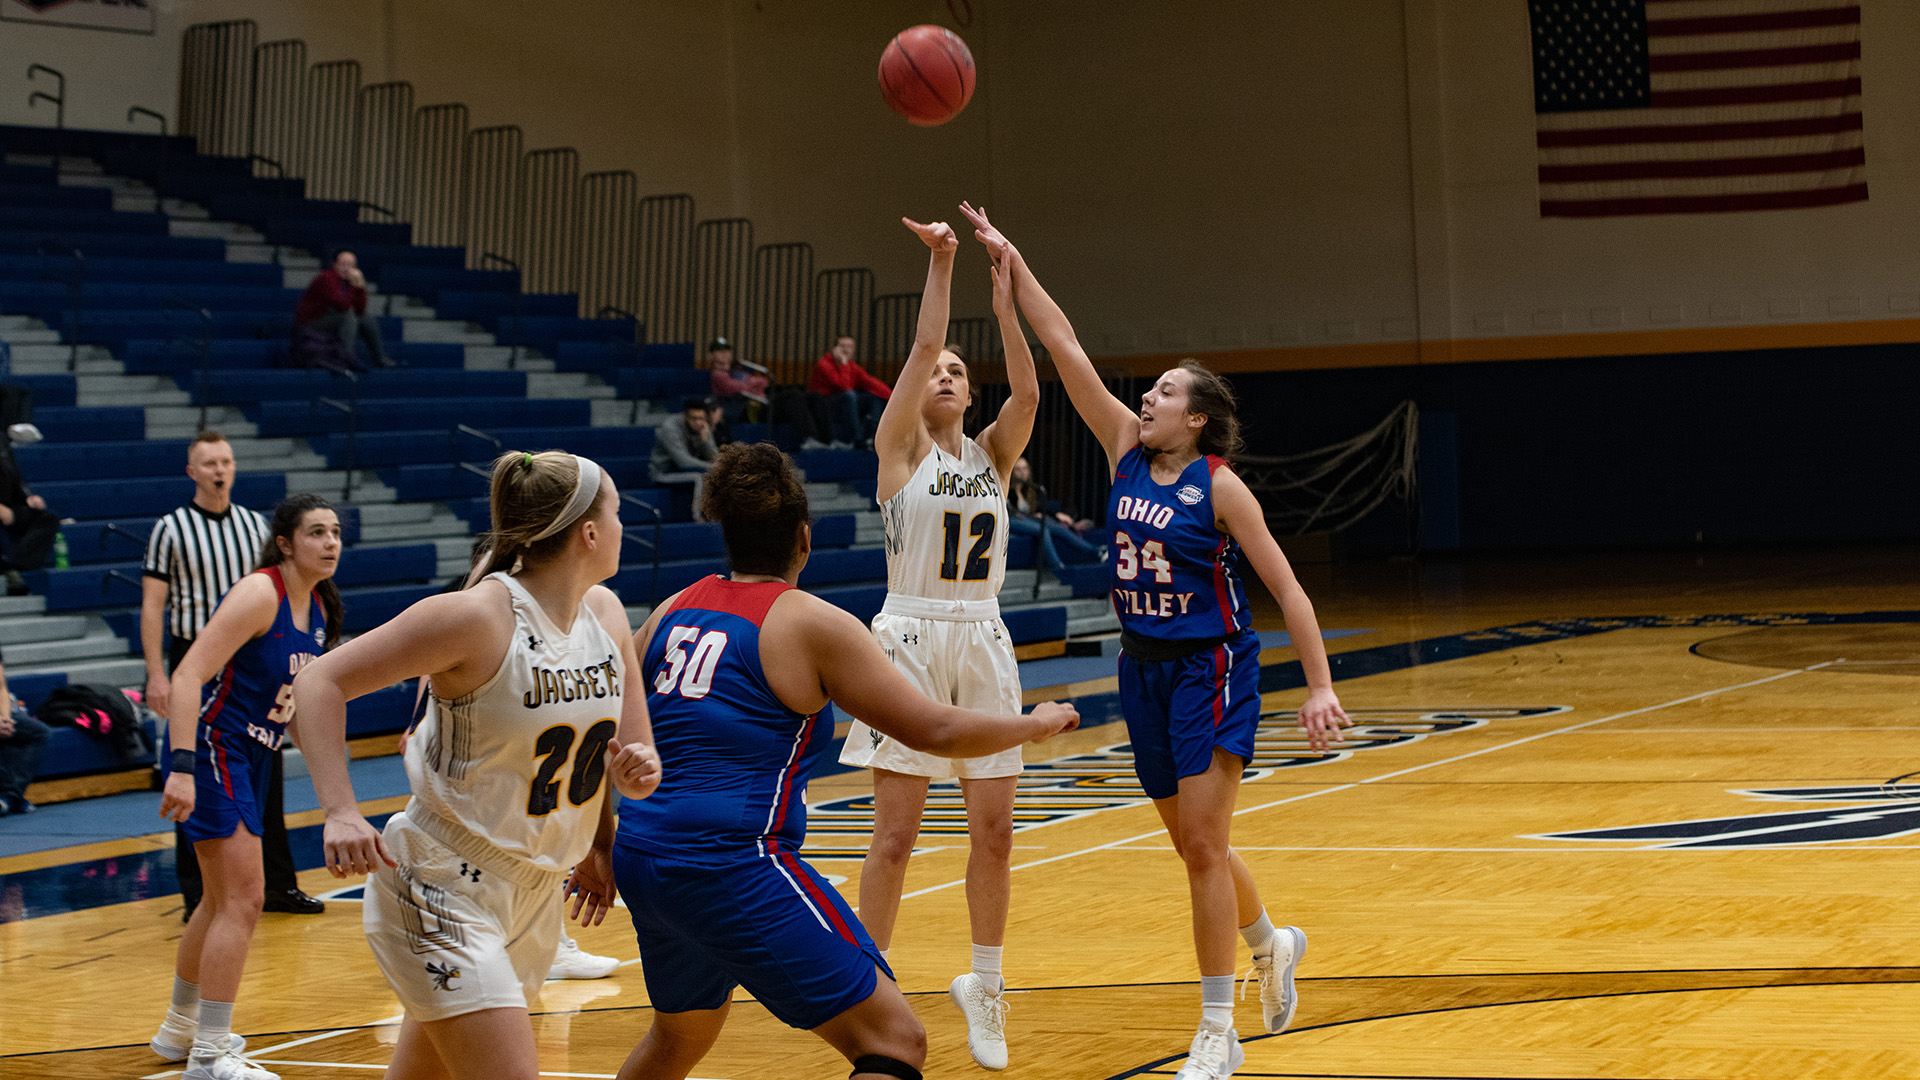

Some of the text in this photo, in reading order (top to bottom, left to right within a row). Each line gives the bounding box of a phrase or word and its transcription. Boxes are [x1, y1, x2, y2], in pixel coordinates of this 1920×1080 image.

[939, 510, 997, 582] 12
[1116, 495, 1175, 530] OHIO
[1114, 530, 1174, 584] 34
[653, 624, 729, 700] 50
[526, 717, 618, 818] 20
